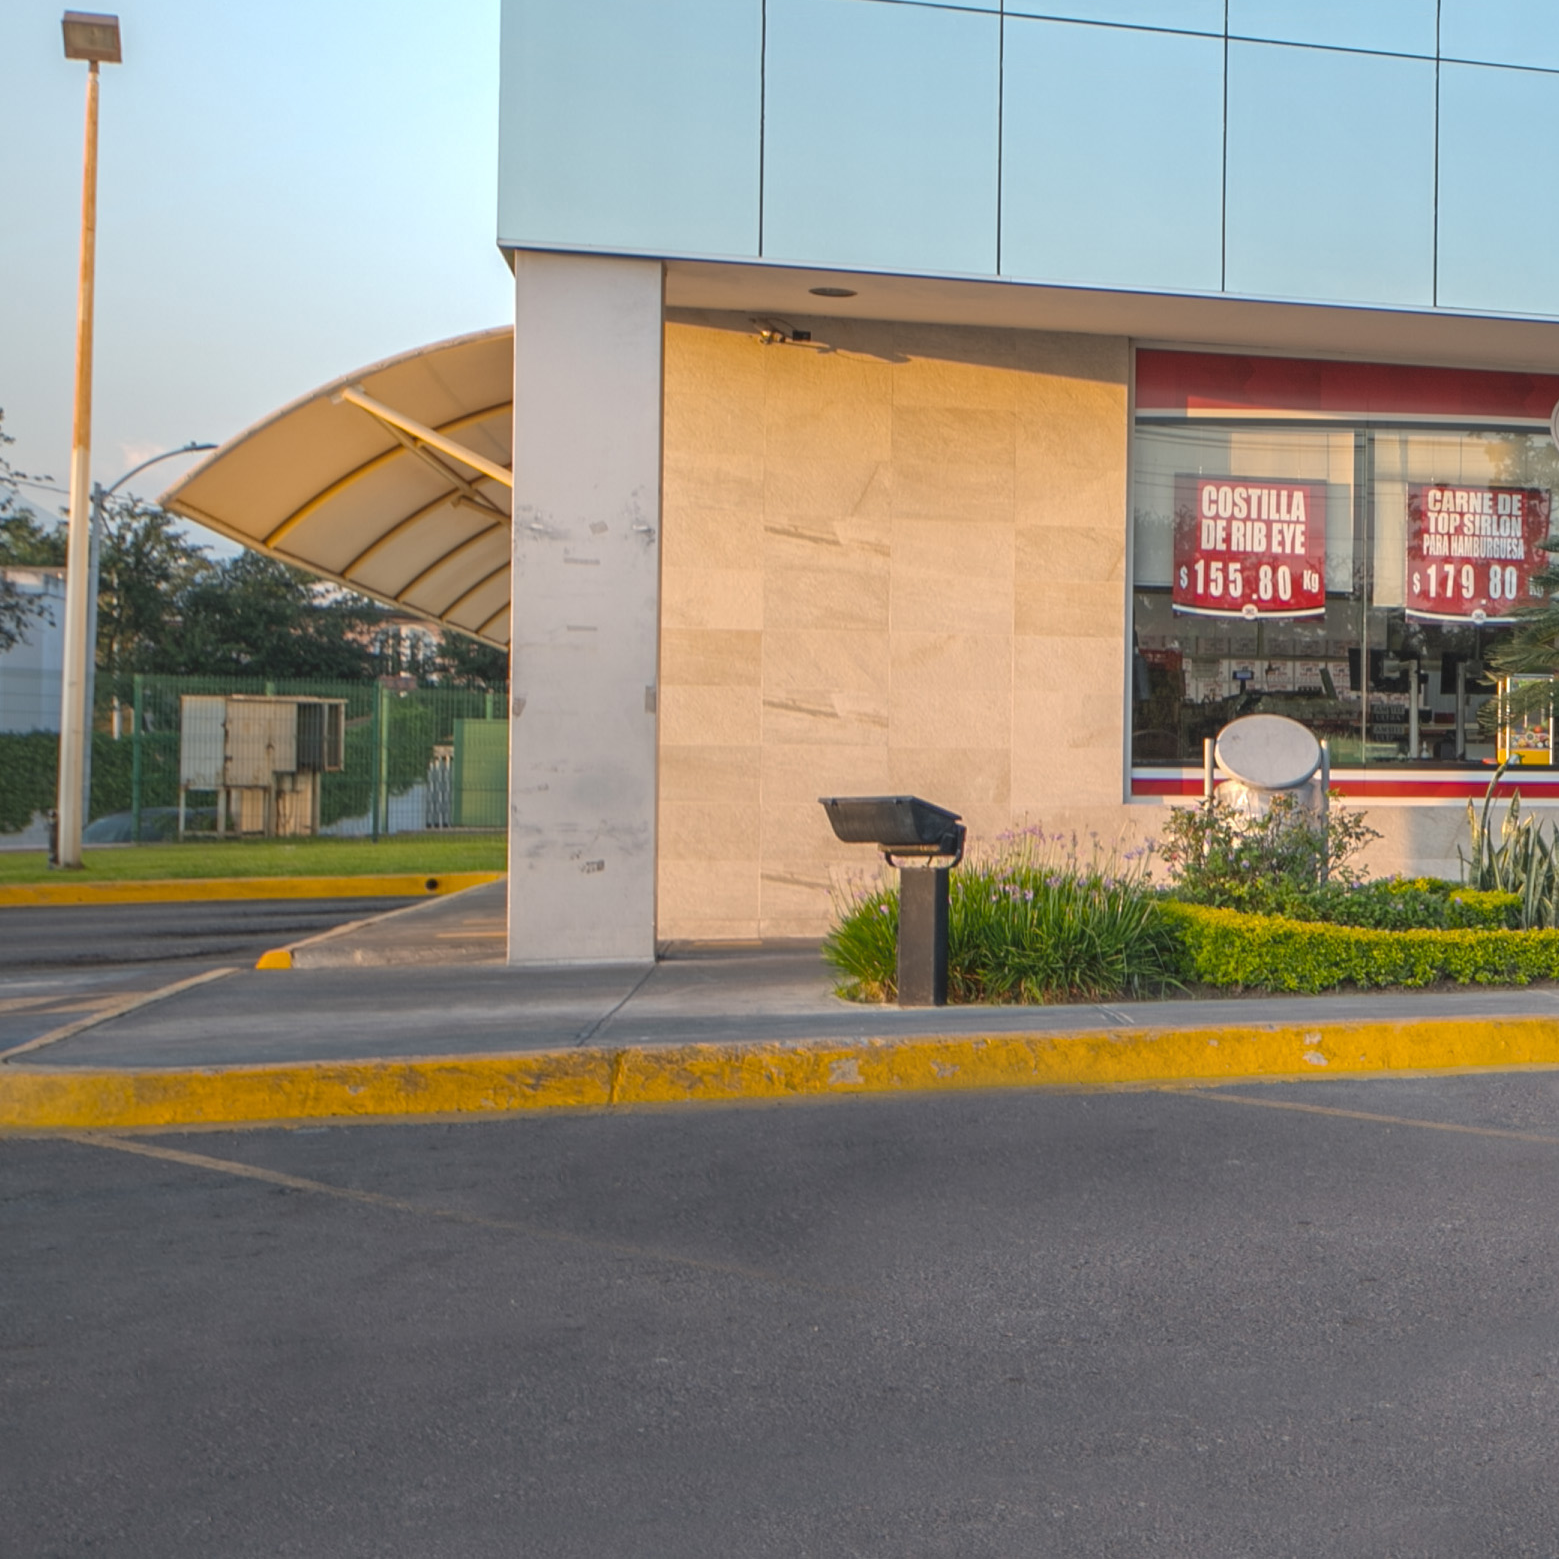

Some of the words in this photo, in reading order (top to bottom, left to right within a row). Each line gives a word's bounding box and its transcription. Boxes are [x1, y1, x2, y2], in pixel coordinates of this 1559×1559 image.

[1202, 485, 1305, 521] COSTILLA
[1427, 489, 1493, 514] CARNE
[1498, 492, 1523, 515] DE
[1201, 518, 1227, 551] DE
[1231, 520, 1267, 552] RIB
[1272, 522, 1305, 554] EYE
[1427, 512, 1460, 534] TOP
[1463, 514, 1523, 537] SIRLON
[1423, 534, 1449, 556] PARA
[1450, 535, 1525, 560] HAMBURGUESA
[1303, 569, 1320, 593] Kg
